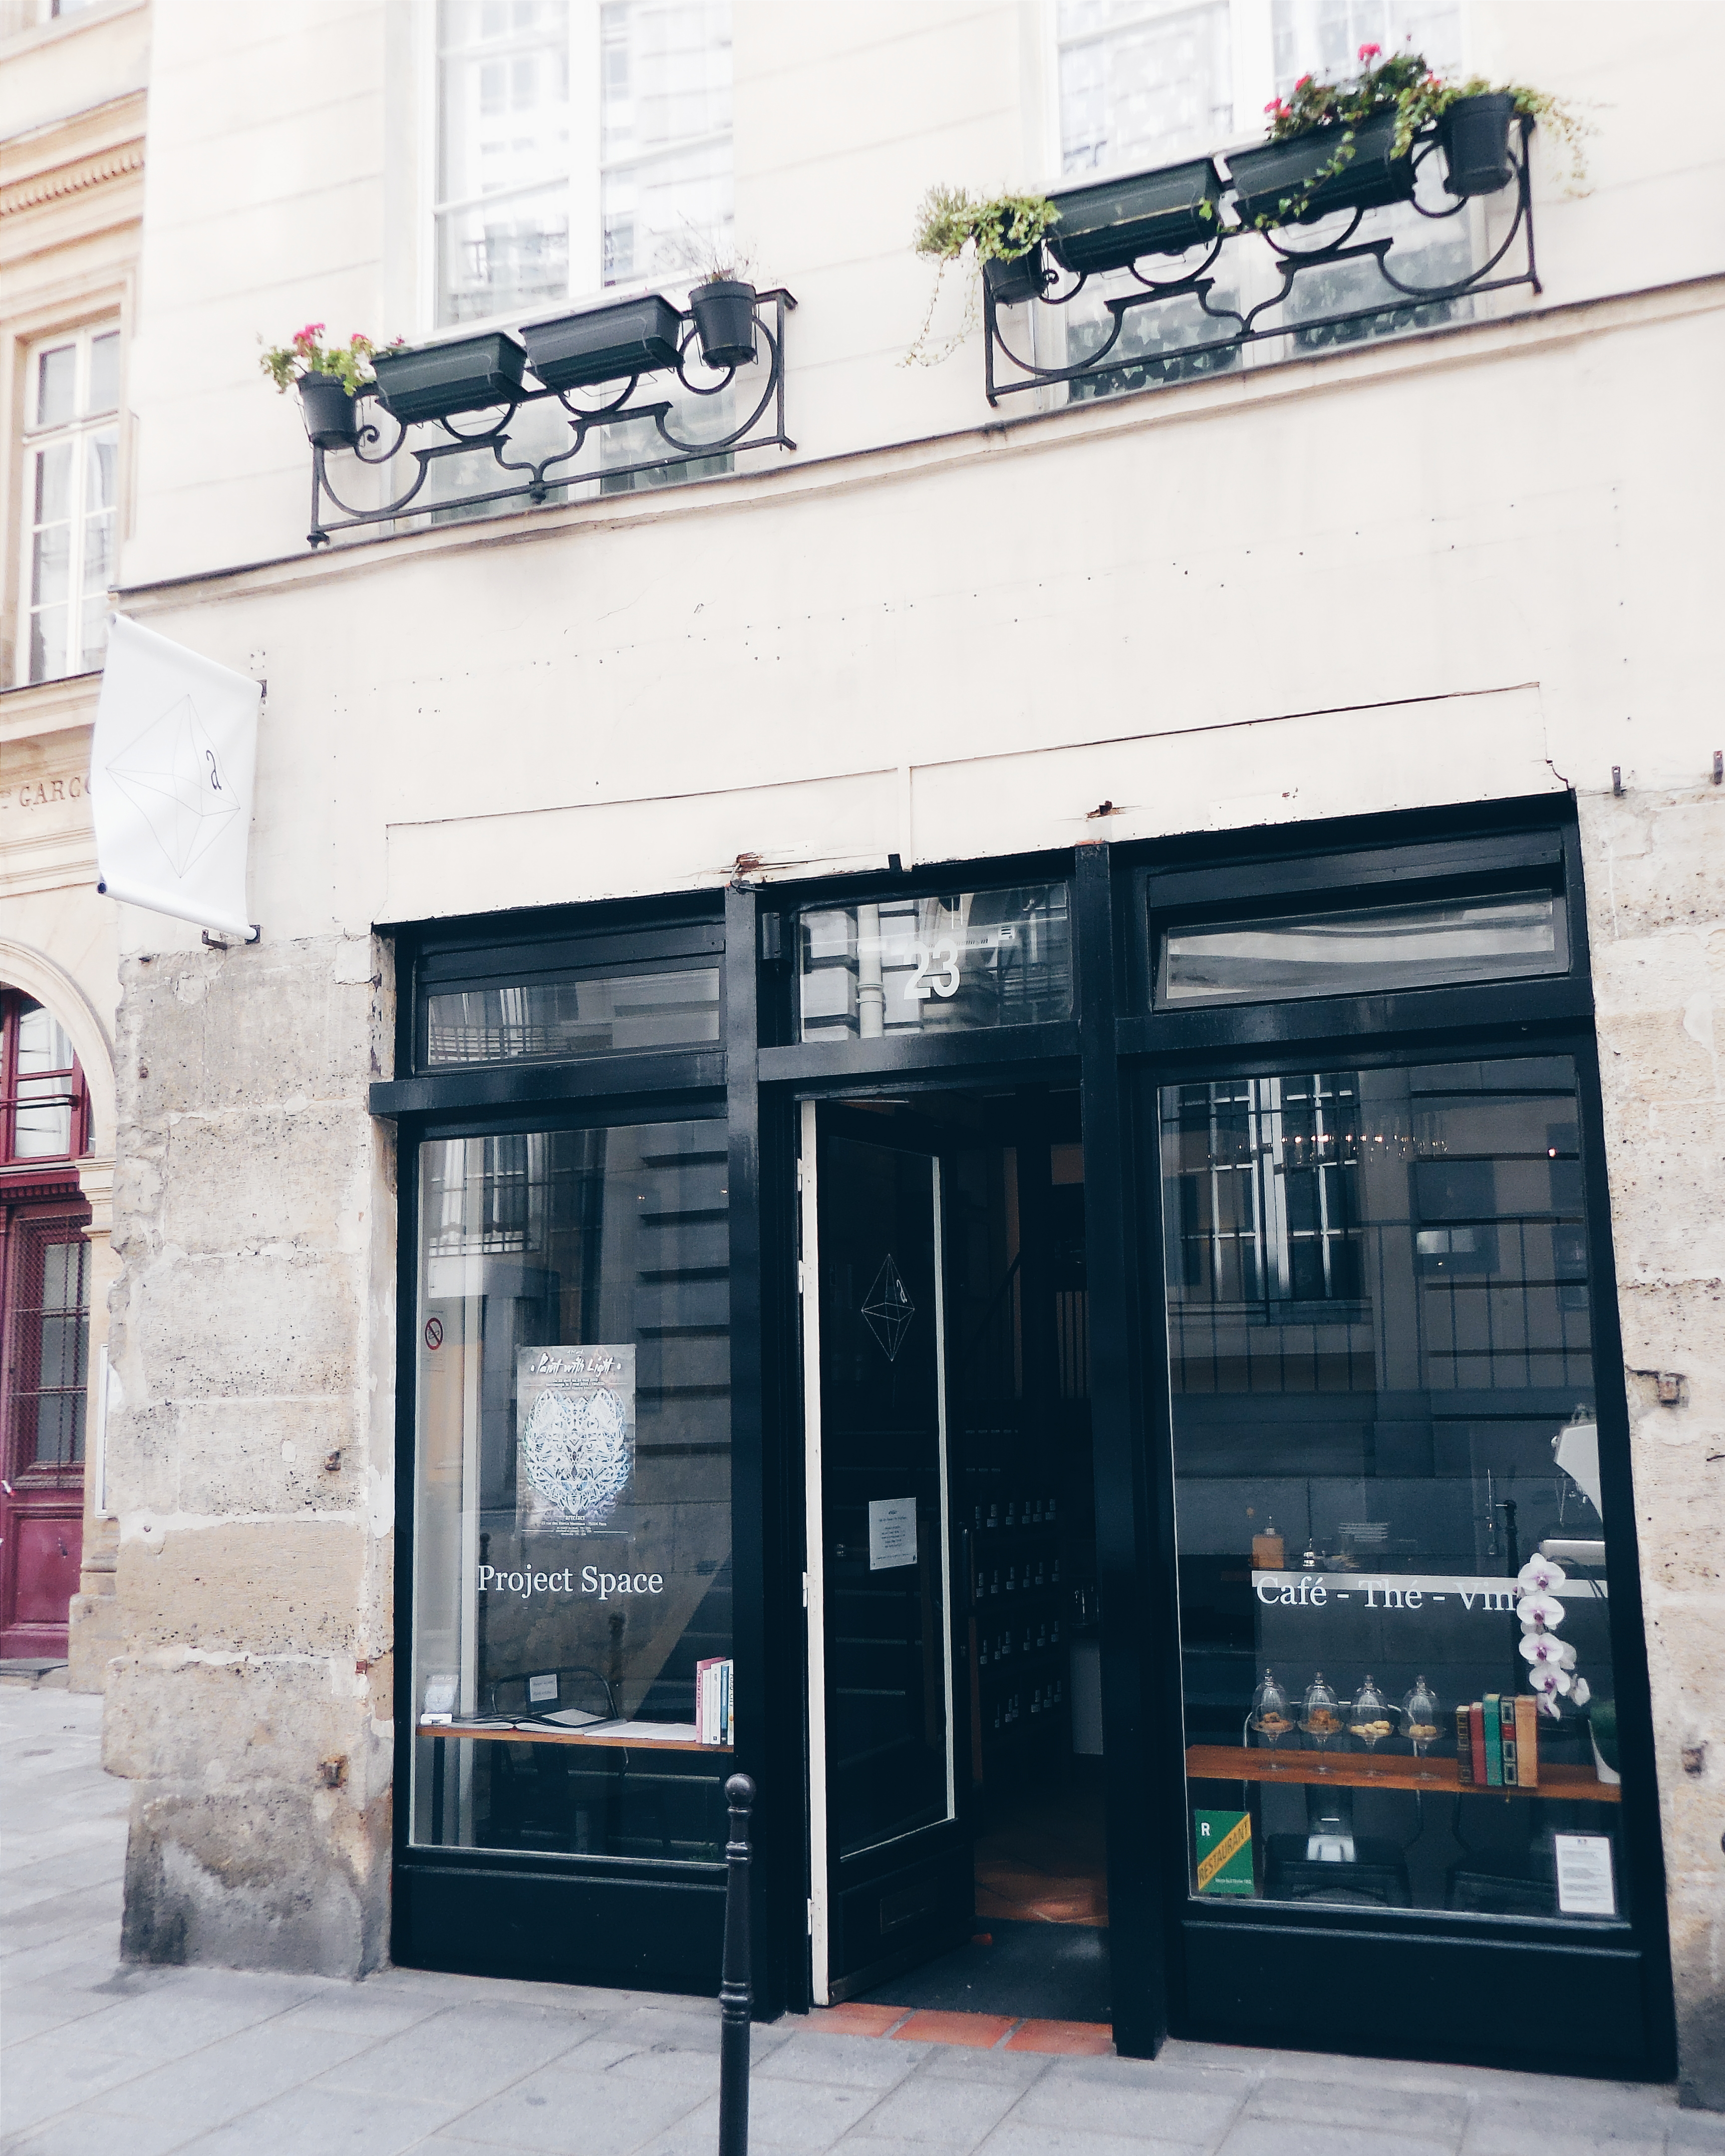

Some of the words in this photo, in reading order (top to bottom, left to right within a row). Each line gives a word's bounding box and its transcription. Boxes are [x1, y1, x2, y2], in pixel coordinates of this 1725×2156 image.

[903, 938, 960, 1000] 23
[536, 1352, 564, 1376] Paint
[563, 1356, 585, 1376] with
[586, 1356, 615, 1377] Light
[478, 1564, 574, 1599] Project
[581, 1565, 663, 1600] Space
[1256, 1577, 1327, 1606] Café
[1358, 1579, 1423, 1609] Thé
[1201, 1822, 1210, 1836] R
